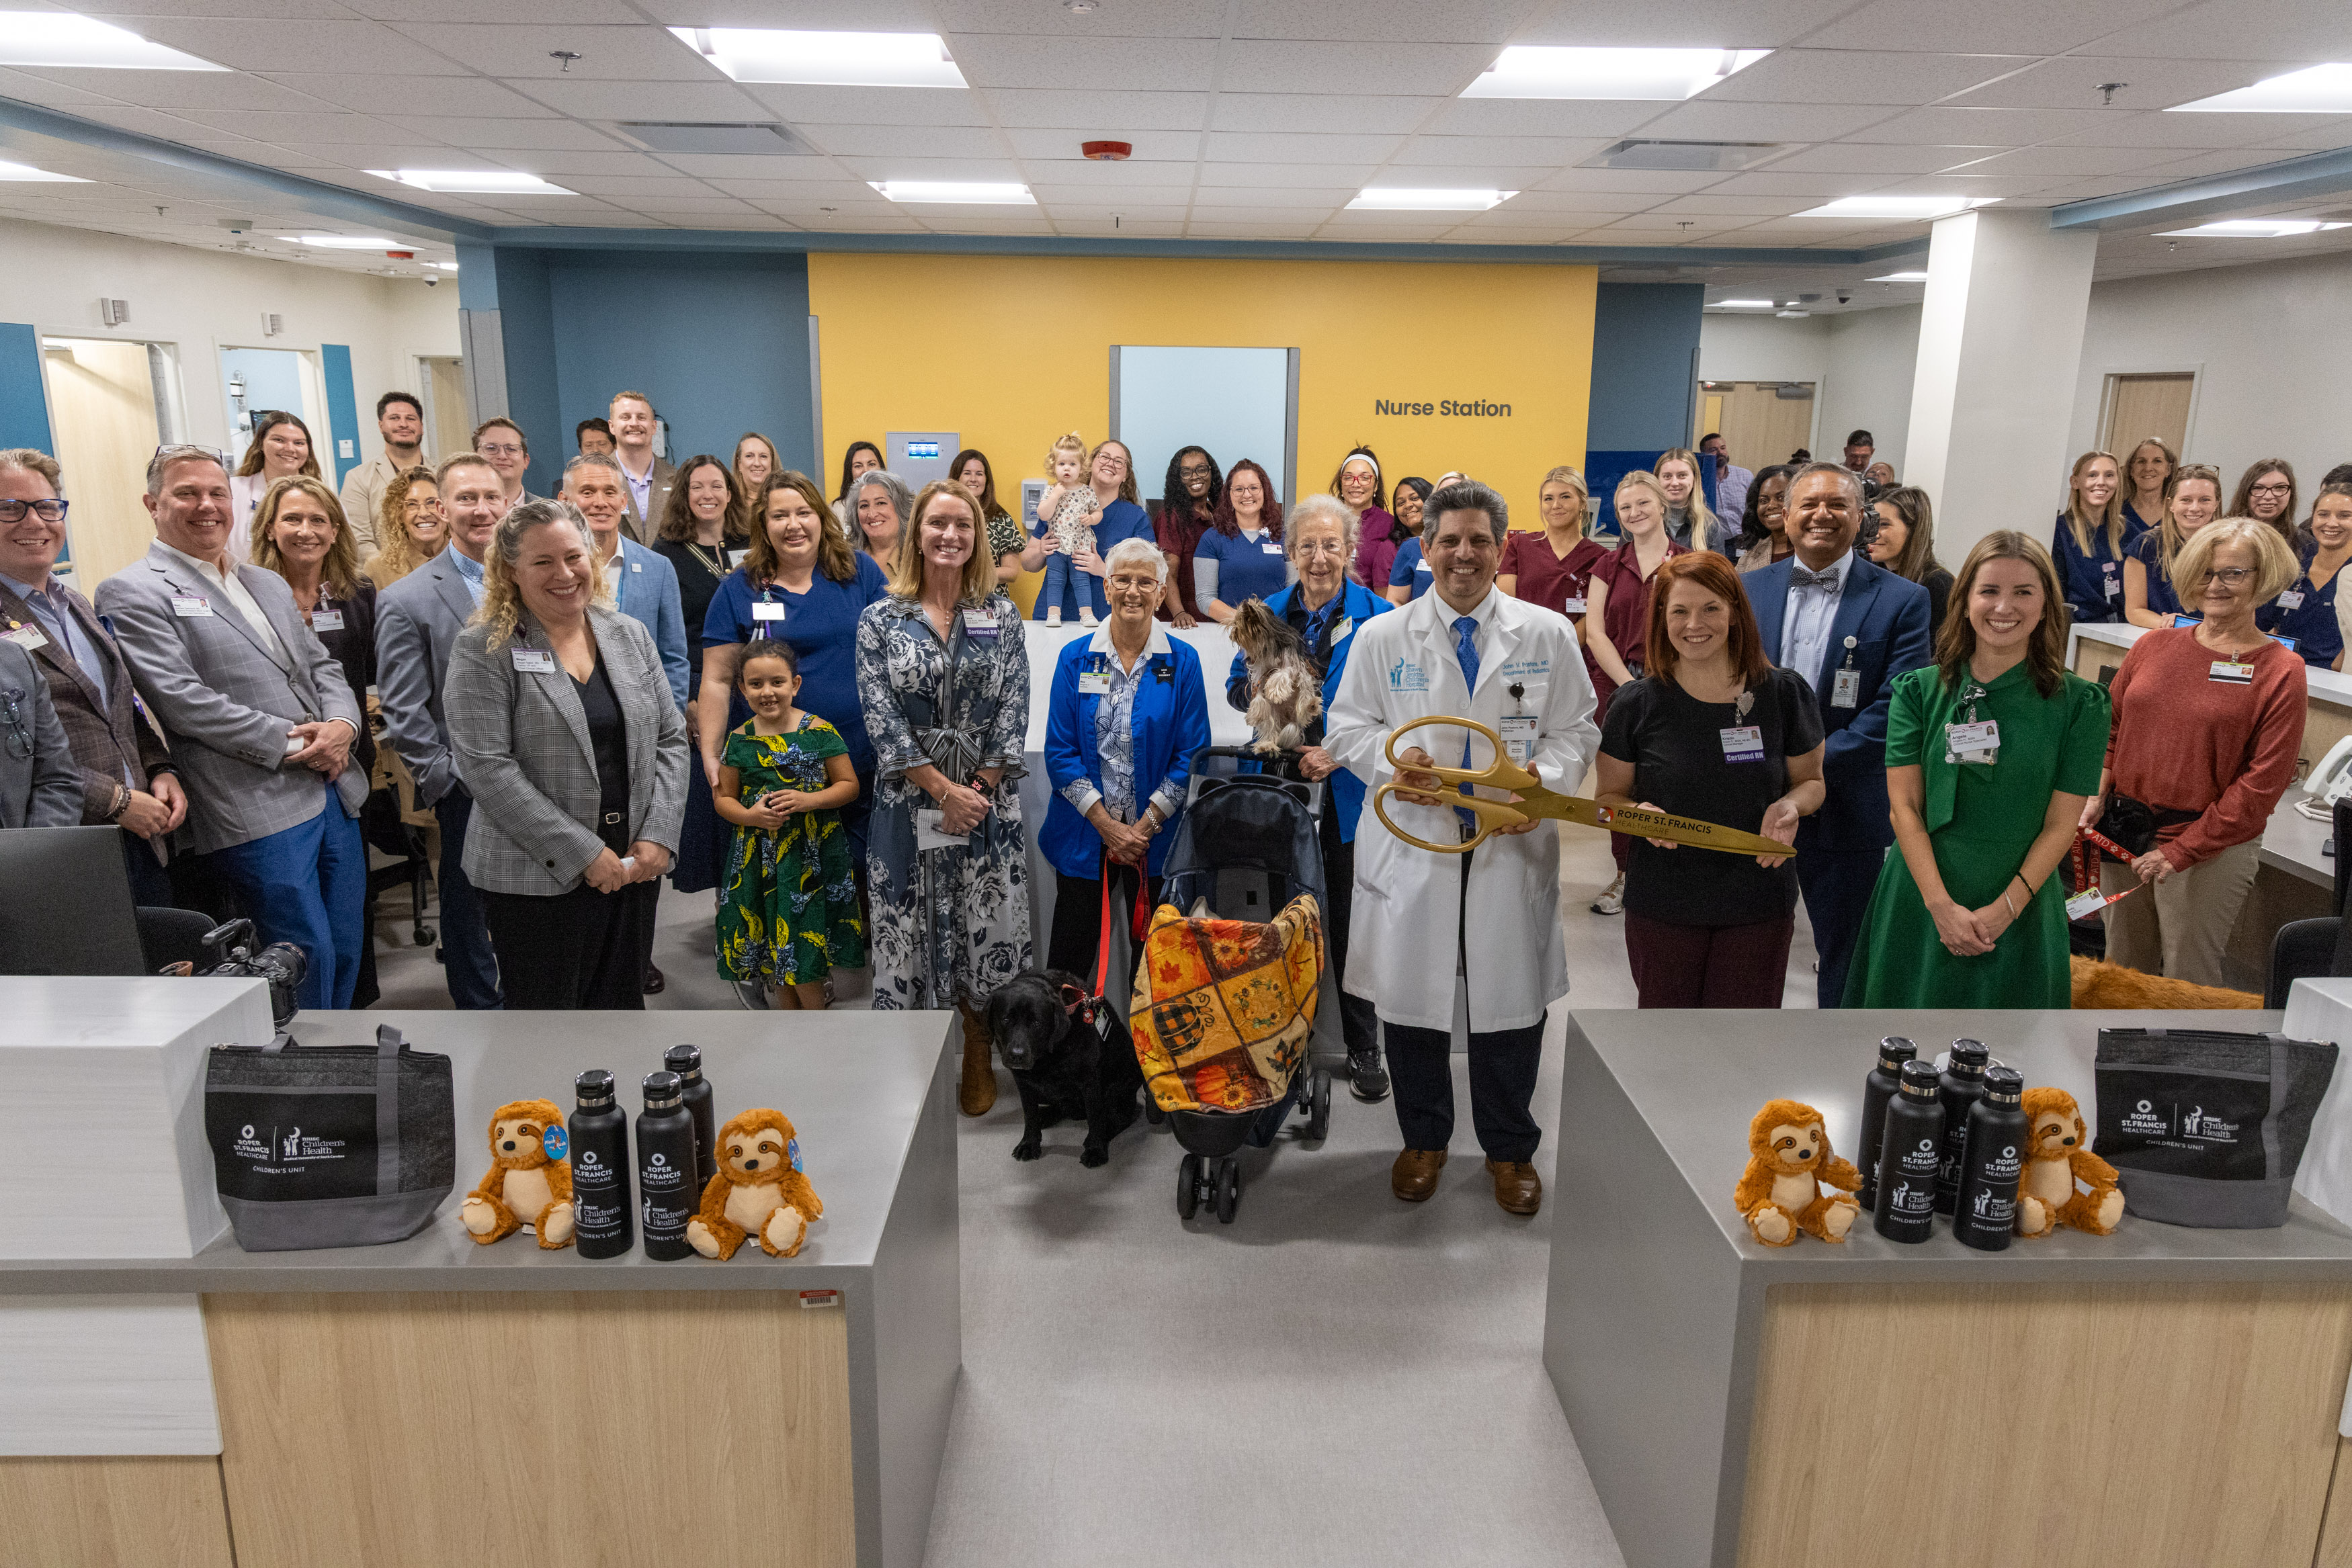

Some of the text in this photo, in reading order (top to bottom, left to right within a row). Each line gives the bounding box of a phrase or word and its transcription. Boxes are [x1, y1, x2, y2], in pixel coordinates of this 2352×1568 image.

[1376, 399, 1511, 417] Nurse Station
[1726, 752, 1755, 761] Certified
[1617, 810, 1651, 822] ROPER
[1615, 820, 1671, 835] HEALTHCARE
[2091, 834, 2110, 847] ATD
[2072, 839, 2081, 855] ATD
[2091, 857, 2099, 873] ATD
[2107, 895, 2117, 904] AT
[2130, 1113, 2157, 1121] ROPER
[2203, 1121, 2239, 1131] Children's
[2122, 1127, 2165, 1135] HEALTHCARE
[2202, 1128, 2231, 1138] Health
[302, 1139, 345, 1147] Children's
[2146, 1139, 2186, 1148] CHILDREN'S
[237, 1151, 268, 1160] HEALTHCARE
[303, 1147, 333, 1155] Health
[253, 1166, 286, 1174] CHILDREN'S
[643, 1178, 680, 1186] HEALTHCARE
[1908, 1202, 1931, 1210] Health
[584, 1206, 621, 1217] Children's
[652, 1208, 689, 1219] Children's
[653, 1218, 679, 1226] Health
[1890, 1215, 1925, 1224] CHILDREN'S
[1971, 1222, 2007, 1231] CHILDREN'S
[607, 1229, 621, 1237] UNIT
